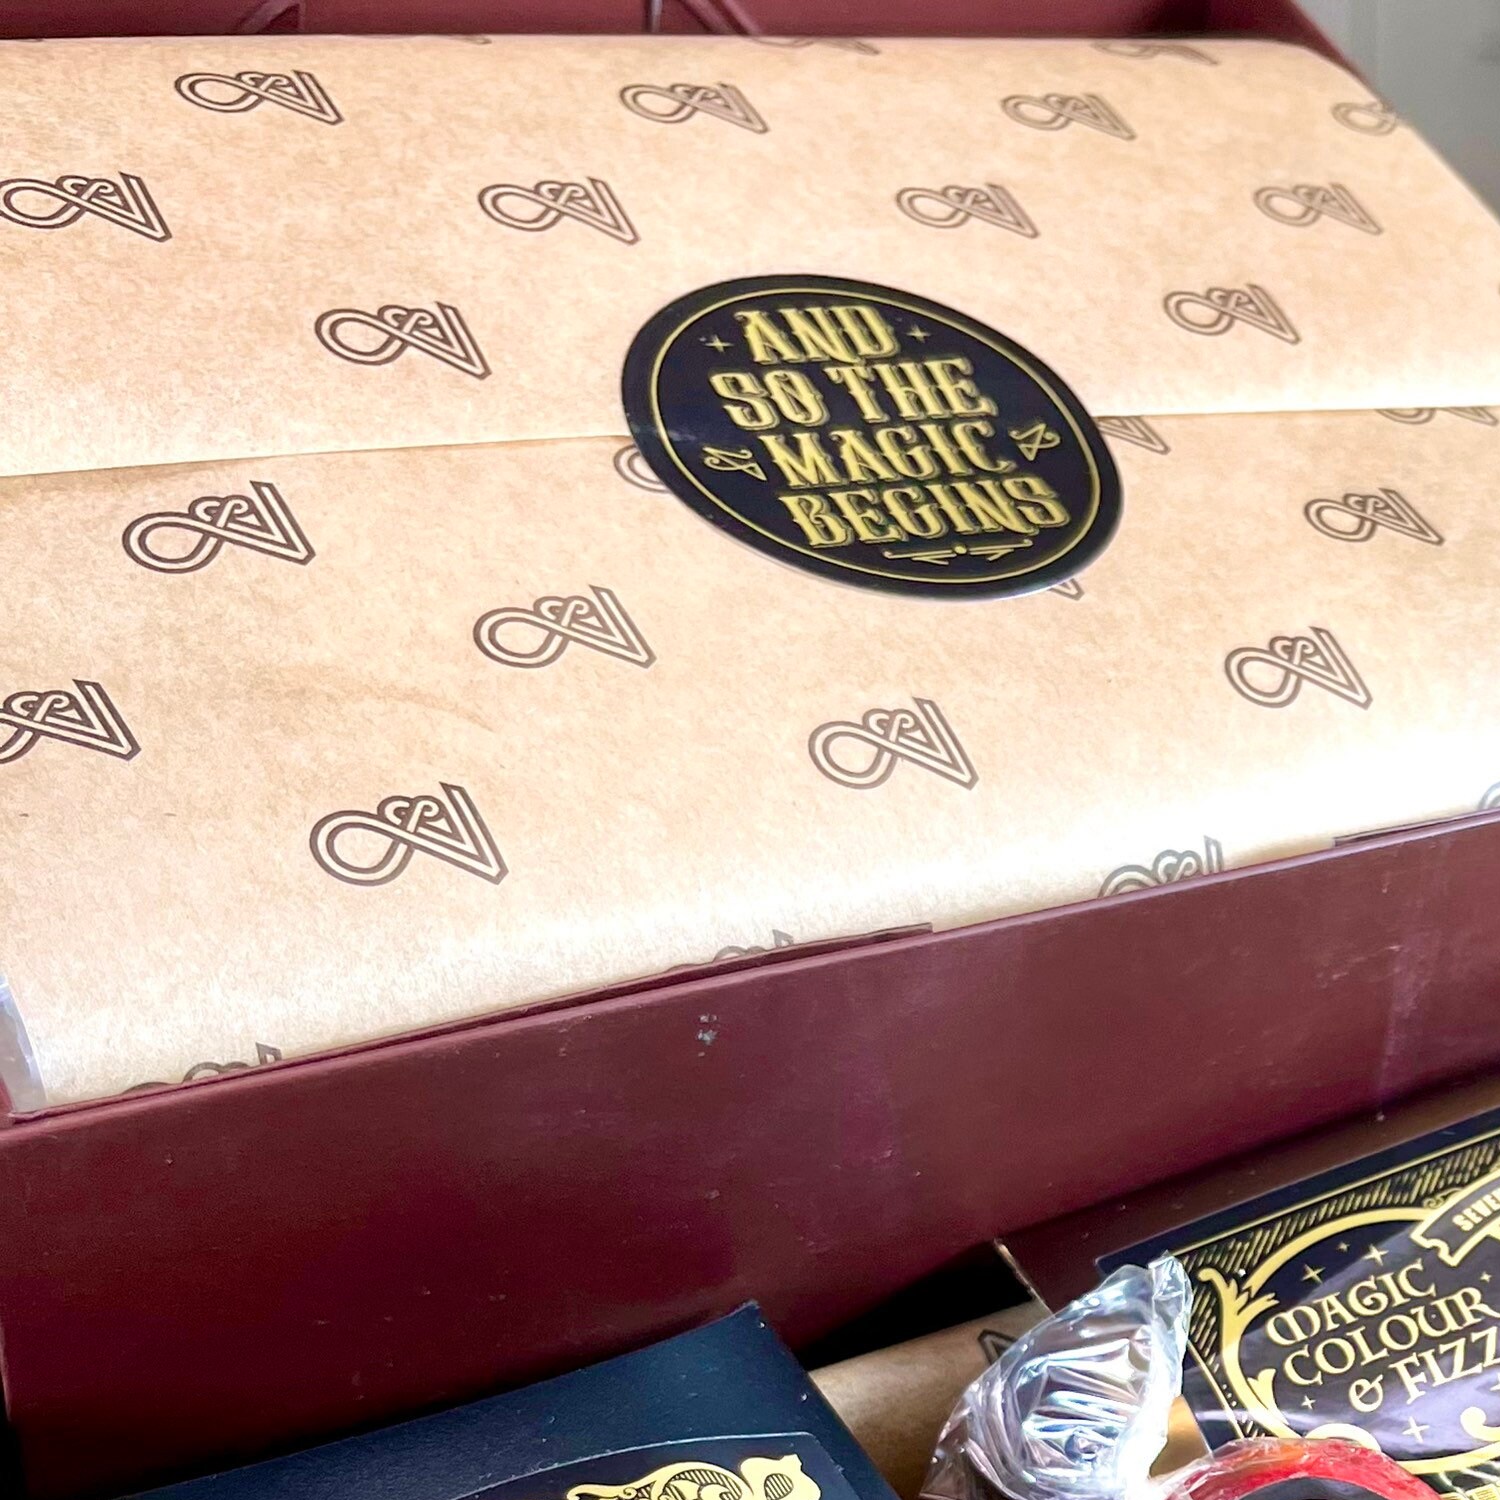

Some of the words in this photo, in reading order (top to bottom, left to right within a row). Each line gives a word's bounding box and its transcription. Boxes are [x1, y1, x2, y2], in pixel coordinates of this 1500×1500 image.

[735, 304, 899, 364] AND
[710, 370, 828, 430] SO
[826, 357, 1000, 422] THE
[759, 420, 1017, 488] MAGIC
[778, 476, 1071, 547] BEGINS
[1264, 1258, 1437, 1347] MAGIC
[1348, 1376, 1385, 1413] &
